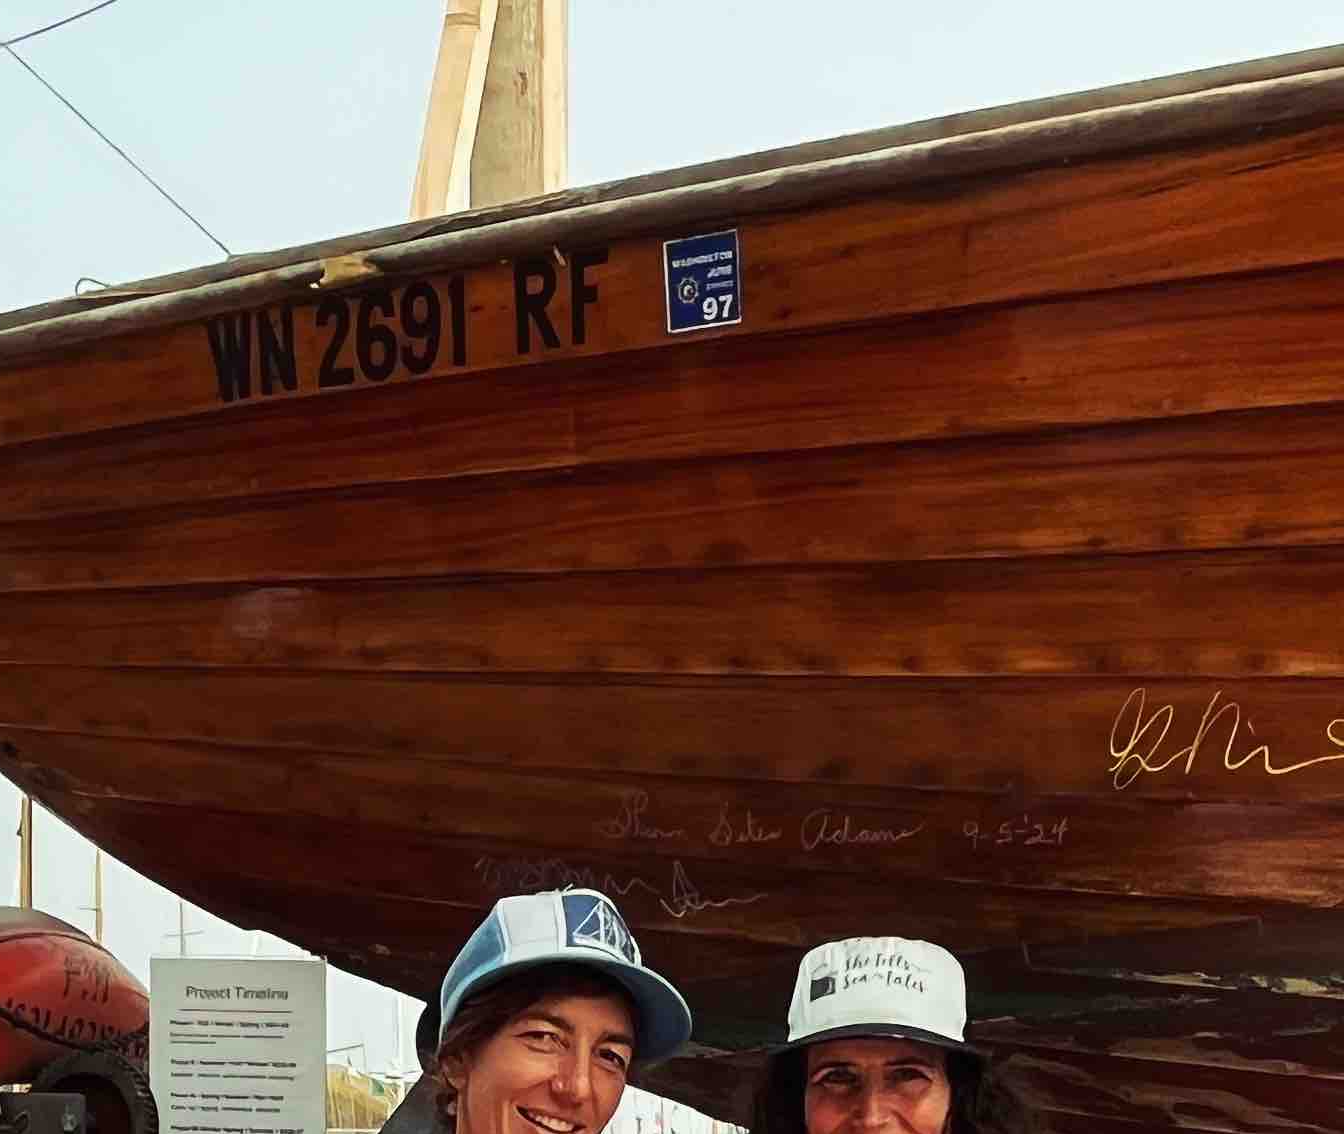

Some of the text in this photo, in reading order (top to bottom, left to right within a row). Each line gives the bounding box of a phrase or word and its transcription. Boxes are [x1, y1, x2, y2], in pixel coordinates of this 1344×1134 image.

[207, 247, 609, 402] WN 2691 RF
[702, 293, 734, 321] 97
